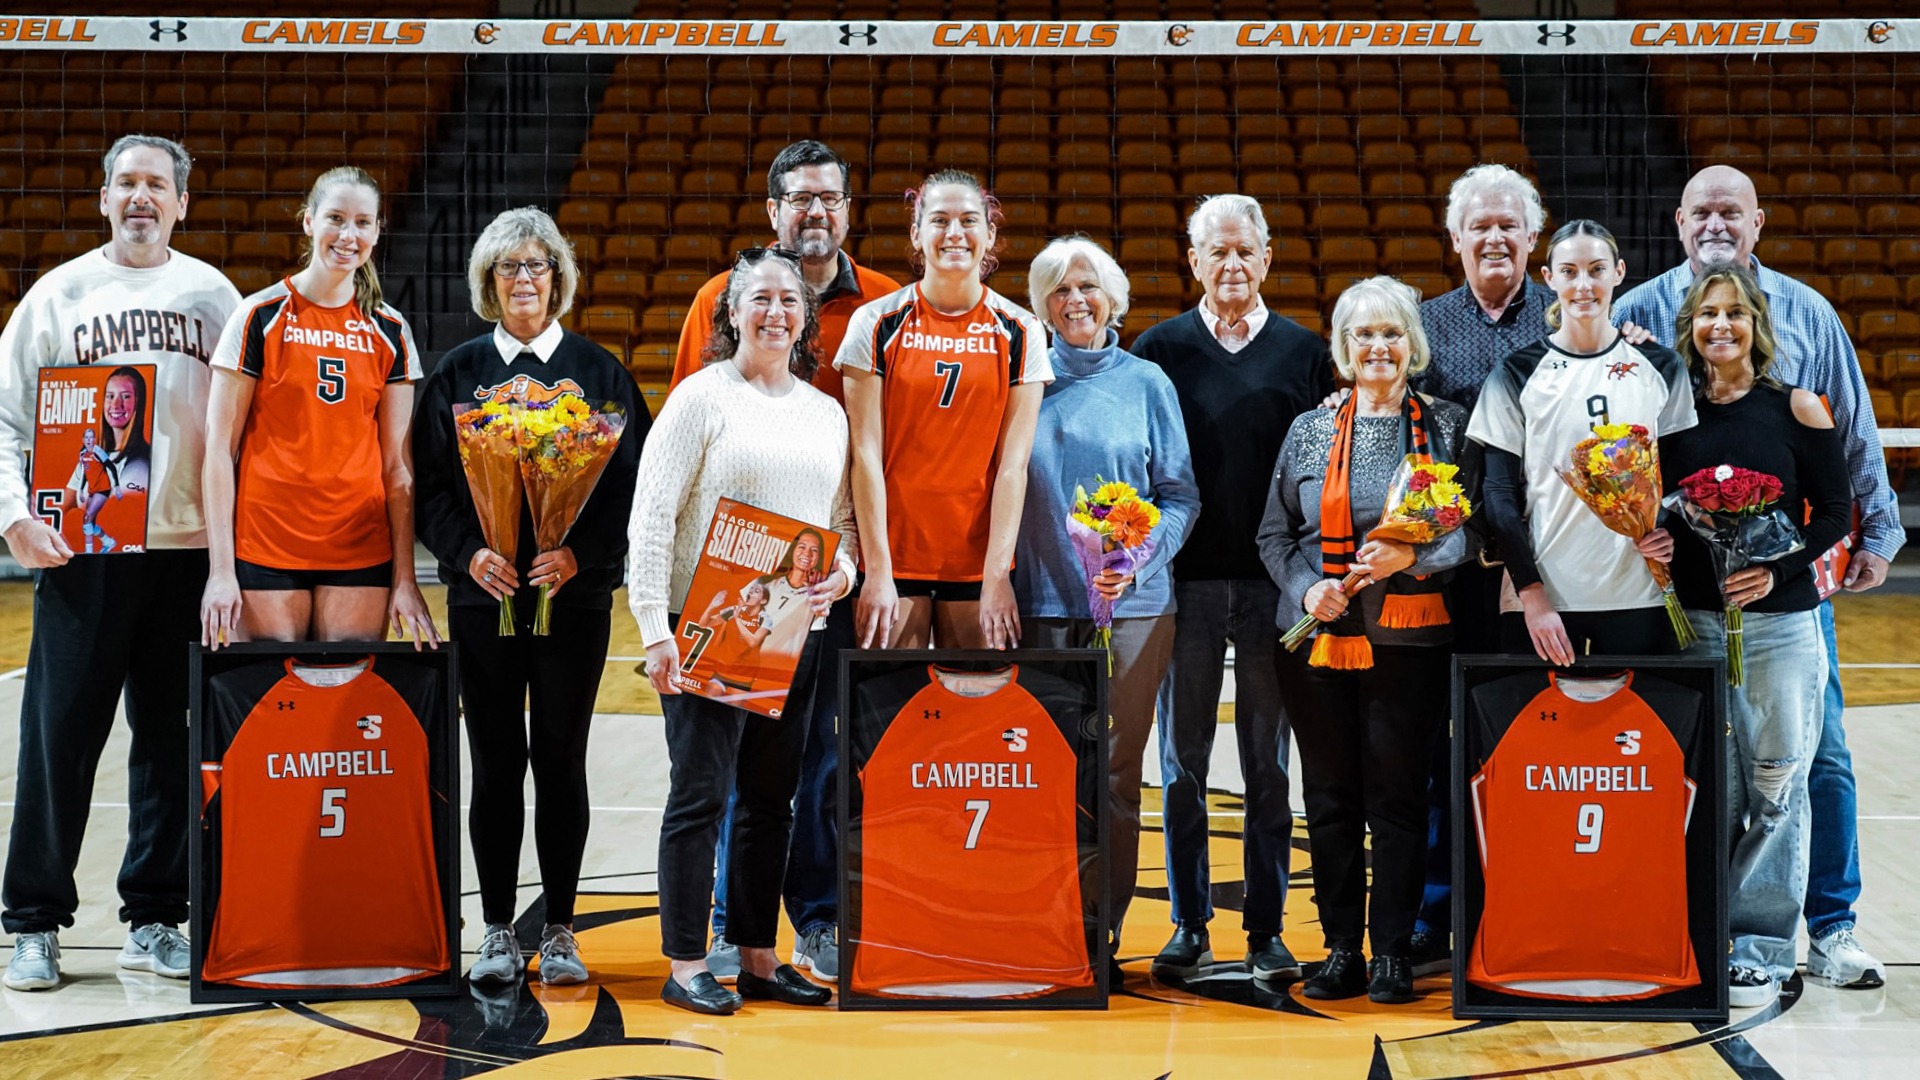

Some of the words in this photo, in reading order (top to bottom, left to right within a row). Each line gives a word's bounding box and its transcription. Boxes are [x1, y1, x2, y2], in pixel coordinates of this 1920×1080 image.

[241, 20, 427, 45] CAMELS
[542, 22, 787, 47] CAMPBELL
[932, 23, 1120, 48] CAMELS
[1236, 23, 1483, 47] CAMPBELL
[1629, 21, 1820, 46] CAMELS
[73, 308, 210, 367] CAMPBELL
[283, 325, 375, 353] CAMPBELL
[344, 319, 375, 335] CAA
[967, 322, 1000, 335] CAA
[901, 332, 998, 355] CAMPBELL
[41, 380, 78, 389] EMILY
[316, 355, 346, 405] 5
[934, 360, 963, 408] 7
[40, 387, 98, 425] CAMPE
[127, 482, 145, 494] CAA
[718, 512, 769, 534] MAGGIE
[706, 520, 792, 575] SALISBURY
[778, 596, 790, 610] 7
[680, 620, 715, 674] 7
[266, 749, 394, 780] CAMPBELL
[911, 762, 1039, 789] CAMPBELL
[1525, 764, 1654, 792] CAMPBELL
[319, 787, 347, 838] 5
[963, 799, 991, 850] 7
[1574, 802, 1605, 854] 9
